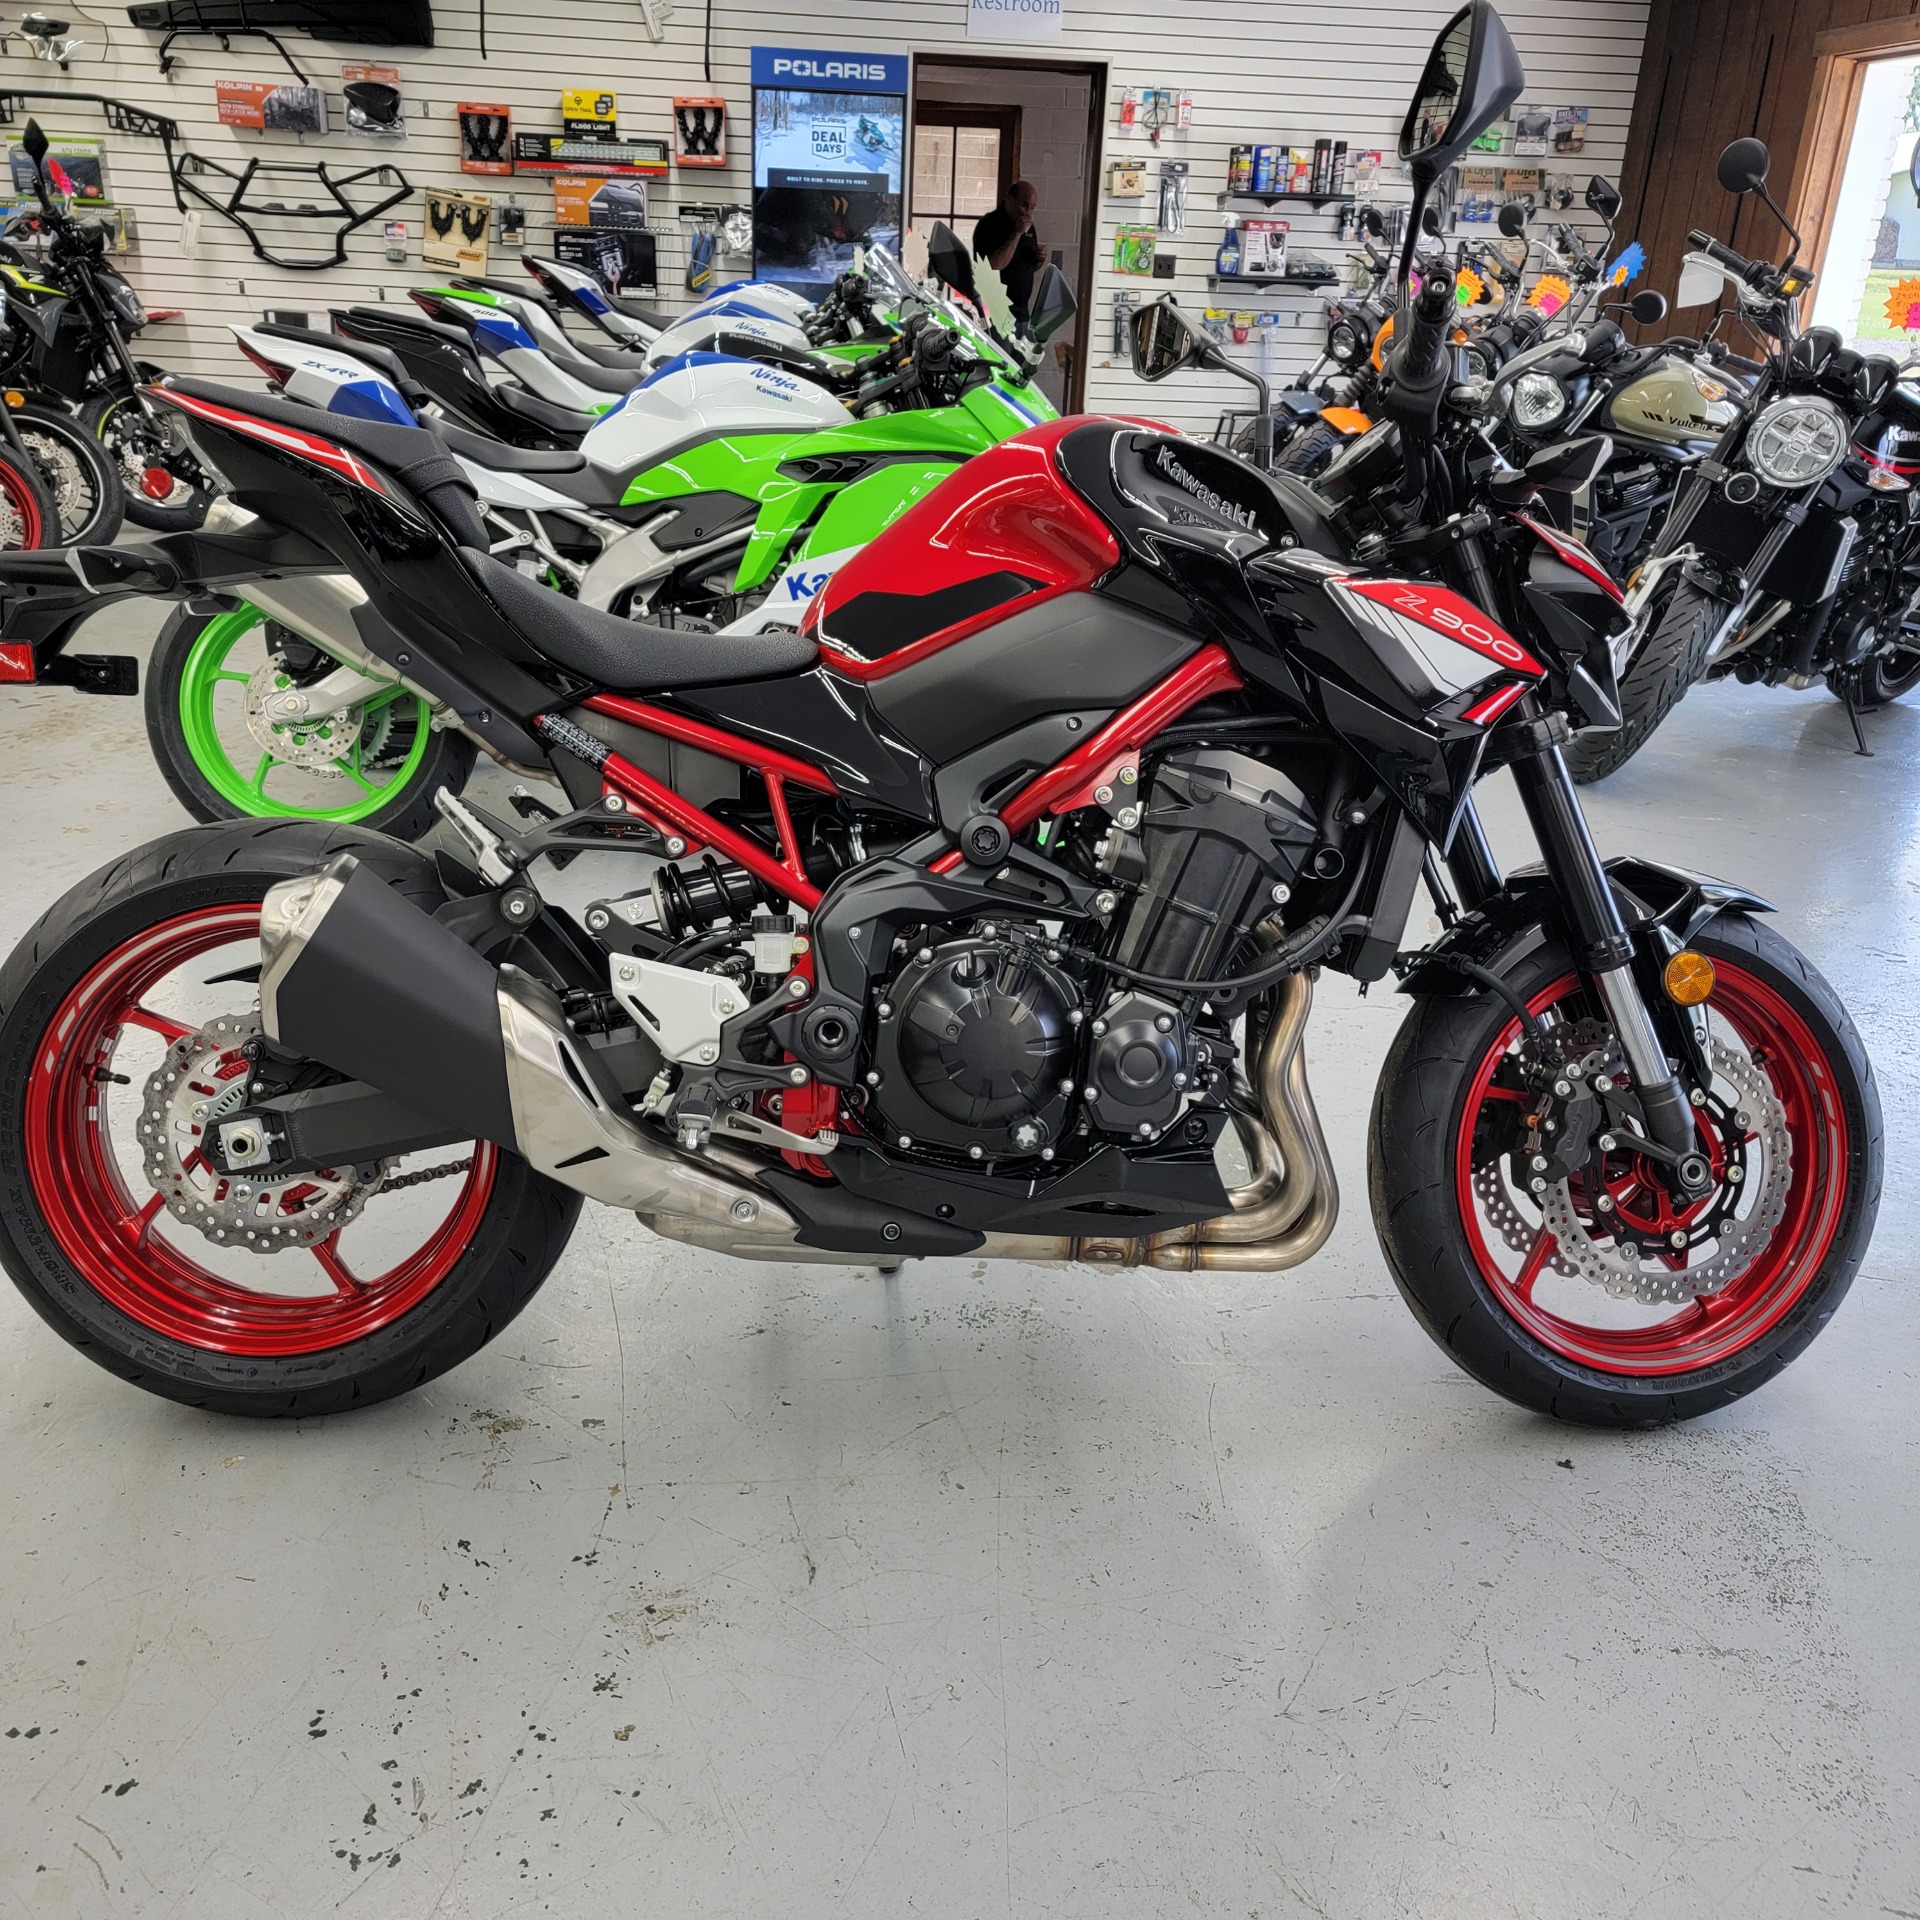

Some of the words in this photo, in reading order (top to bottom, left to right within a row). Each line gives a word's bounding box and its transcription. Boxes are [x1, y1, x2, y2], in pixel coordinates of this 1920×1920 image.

[773, 58, 887, 81] POLARIS
[217, 81, 253, 91] KOLPIN
[570, 122, 591, 130] FLOOD
[593, 123, 611, 131] LIGHT
[811, 116, 847, 124] POLARIS
[811, 131, 847, 143] DEAL
[815, 144, 842, 154] DAYS
[556, 178, 587, 187] KOLPIN
[472, 309, 498, 317] 500
[734, 321, 769, 338] Ninja
[728, 332, 783, 352] Kawasaki
[301, 360, 360, 379] ZX-4RR
[750, 367, 801, 392] Ninja
[755, 384, 793, 403] Kawasaki
[1669, 416, 1708, 431] Vulcan
[1888, 424, 1920, 442] Kaw
[1156, 444, 1257, 531] Kawasaki
